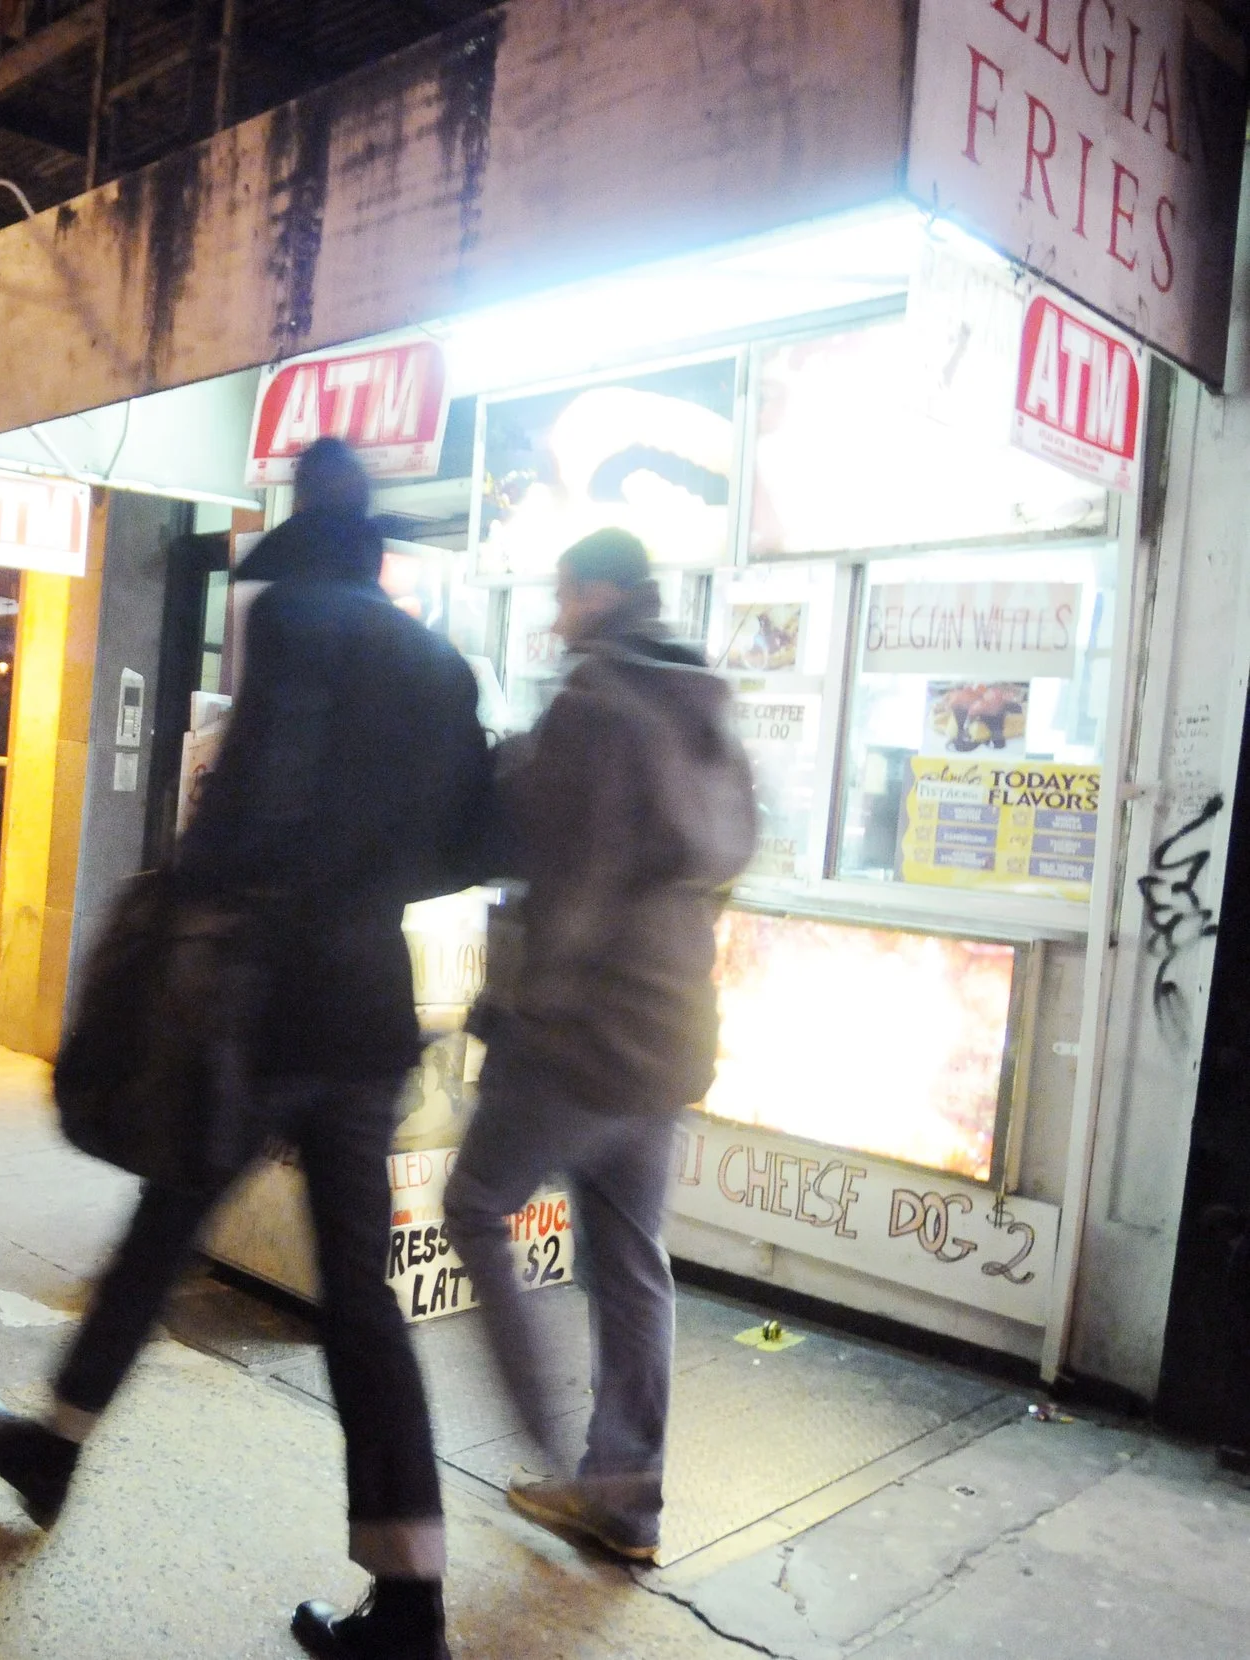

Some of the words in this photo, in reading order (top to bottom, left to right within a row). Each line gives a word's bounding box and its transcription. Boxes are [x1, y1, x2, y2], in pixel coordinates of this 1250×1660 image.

[961, 44, 1177, 293] FRIES
[1024, 304, 1131, 452] ATM
[269, 351, 429, 455] ATM
[866, 604, 965, 652] BELGIAN
[754, 704, 805, 722] COFFEE
[756, 722, 790, 740] 1.00
[988, 789, 1099, 811] FLAVORS
[991, 770, 1100, 792] TODAY'S
[502, 1200, 572, 1242] PPUC
[717, 1143, 867, 1240] CHEESE
[888, 1187, 979, 1264] DOG
[980, 1191, 1036, 1285] $2
[521, 1236, 565, 1288] $2
